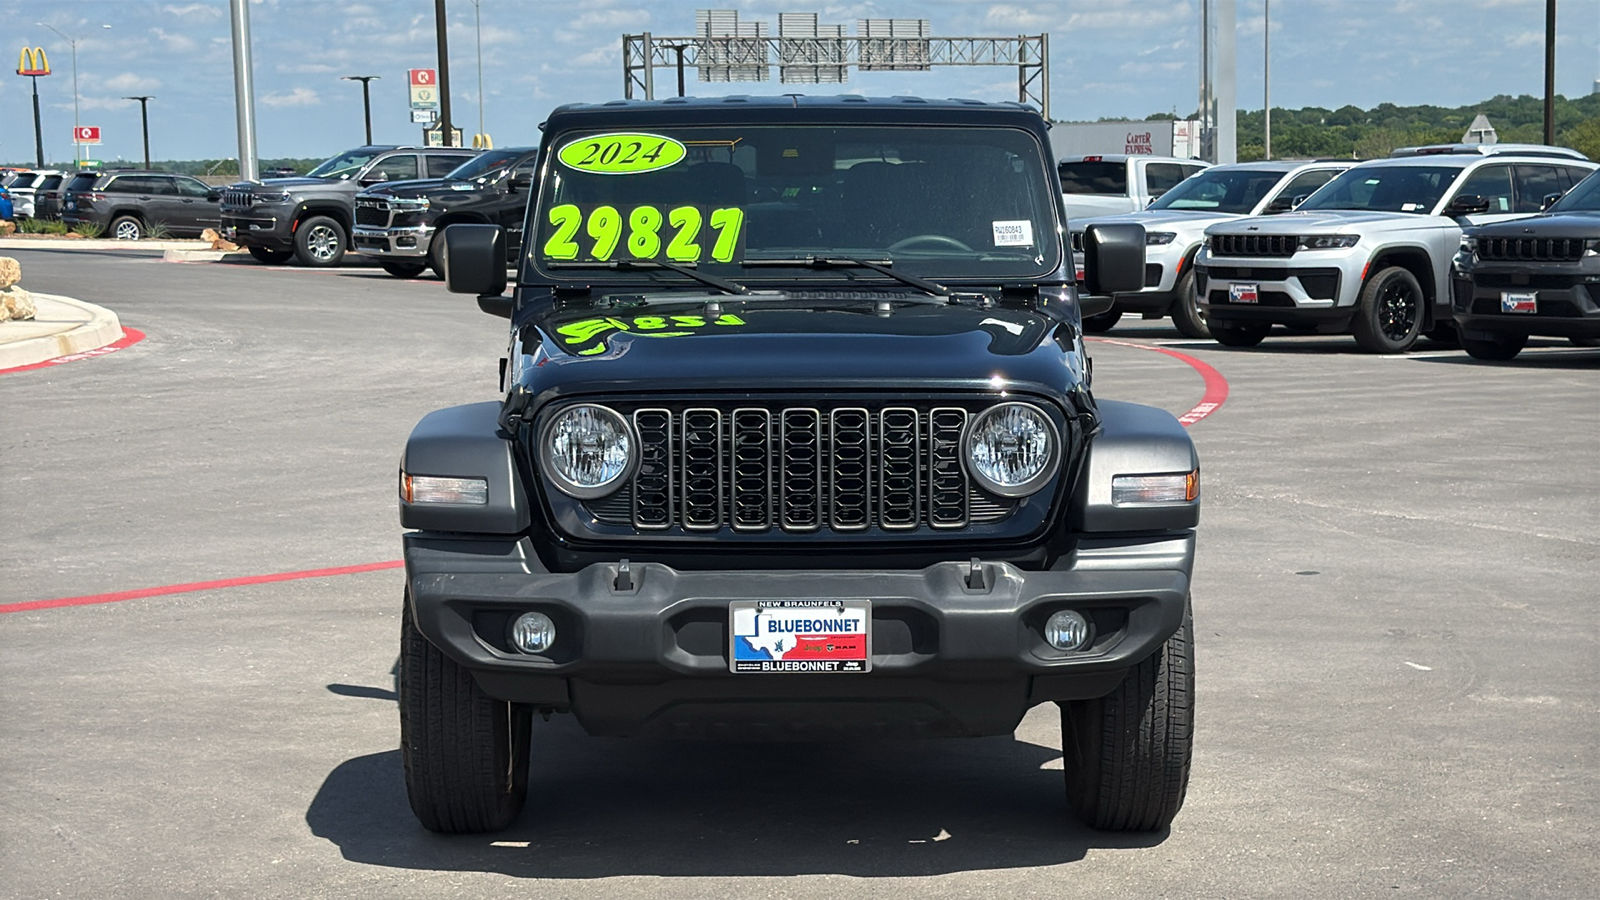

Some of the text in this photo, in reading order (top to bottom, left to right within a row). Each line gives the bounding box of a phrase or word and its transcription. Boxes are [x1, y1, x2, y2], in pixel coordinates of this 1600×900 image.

[1126, 132, 1152, 145] CARTER
[577, 140, 668, 166] 2024
[1124, 144, 1153, 154] EXPRESS
[543, 203, 744, 263] 29827
[768, 619, 860, 633] BLUEBONNET
[762, 661, 840, 671] BLUEBONNET
